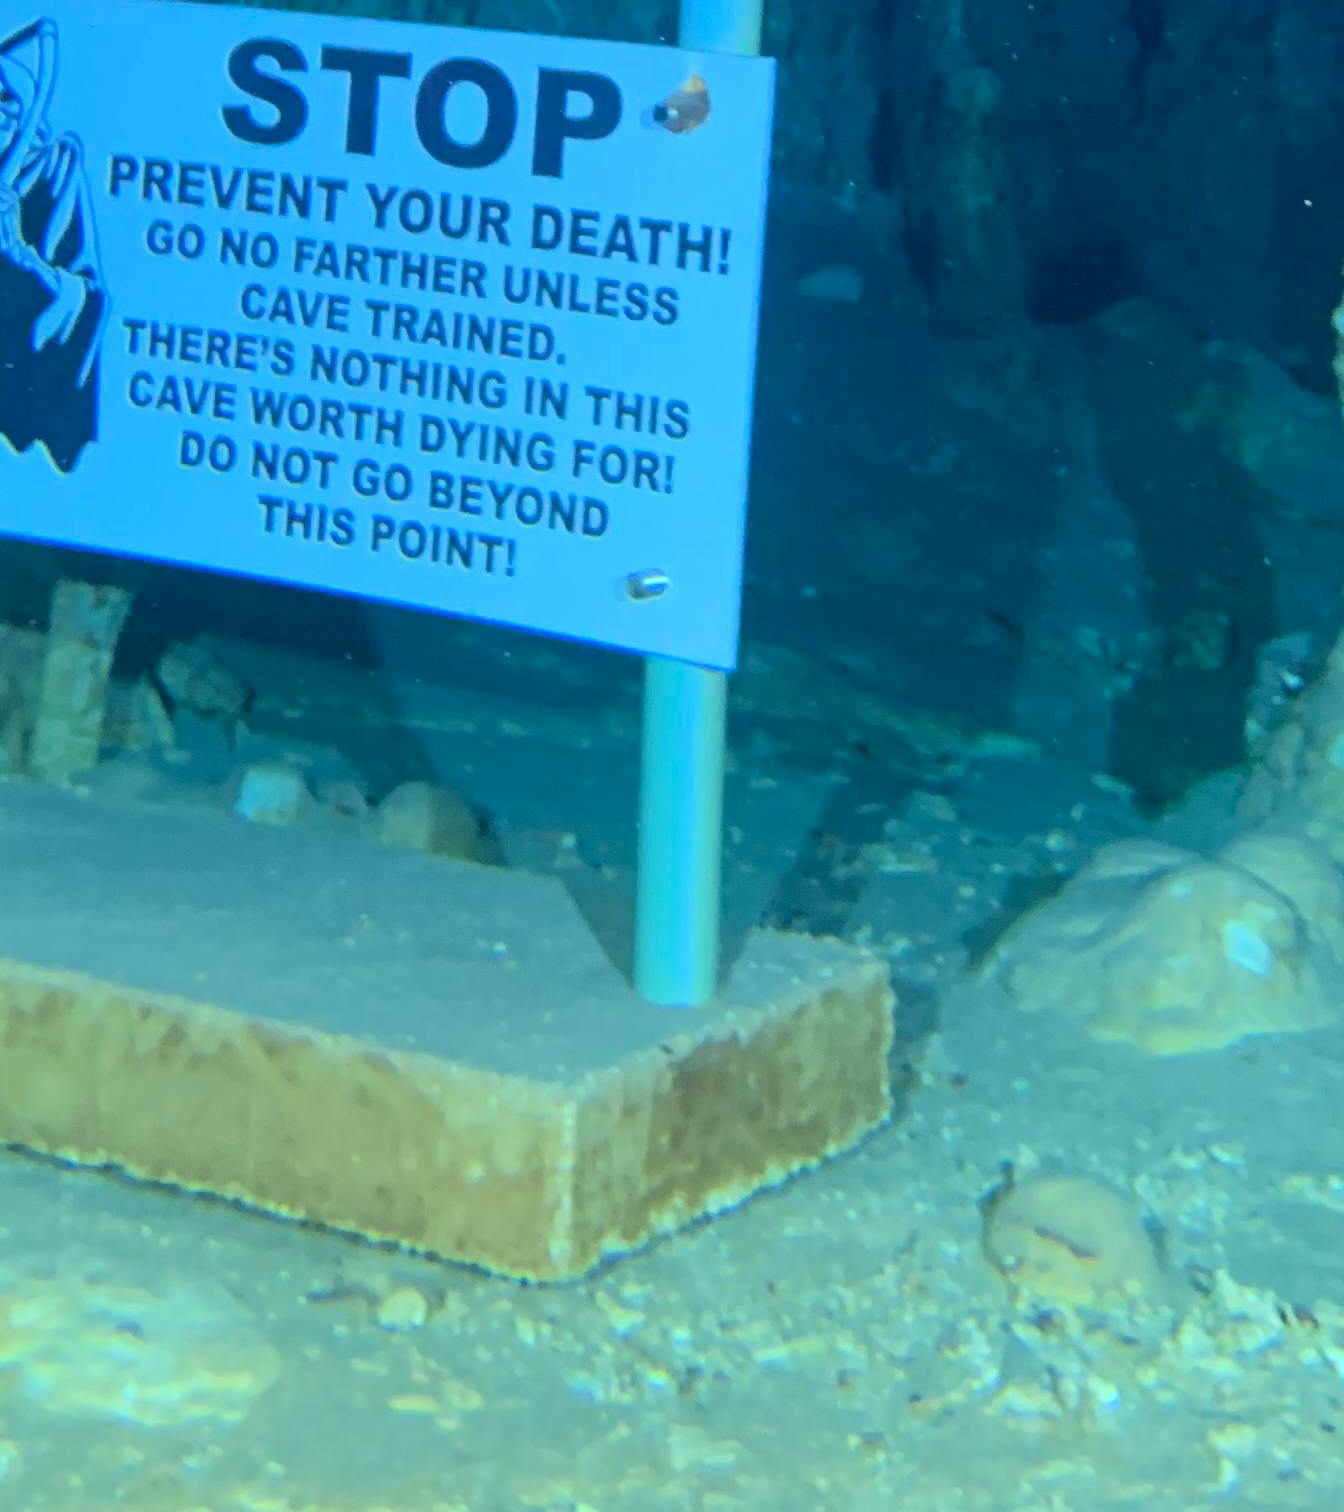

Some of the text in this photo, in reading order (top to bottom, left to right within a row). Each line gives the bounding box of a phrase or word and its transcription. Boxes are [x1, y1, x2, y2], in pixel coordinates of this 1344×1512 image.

[223, 38, 622, 178] STOP
[110, 154, 731, 274] PREVENT YOUR DEATH!
[147, 220, 678, 324] GO NO FARTHER UNLESS
[242, 284, 564, 364] CAVE TRAINED.
[123, 318, 688, 438] THERE'S NOTHING IN THIS
[130, 371, 674, 494] CAVE WORTH DYING FOR!
[181, 430, 608, 536] DO NOT GO BEYOND
[258, 495, 515, 576] THIS POINT!
